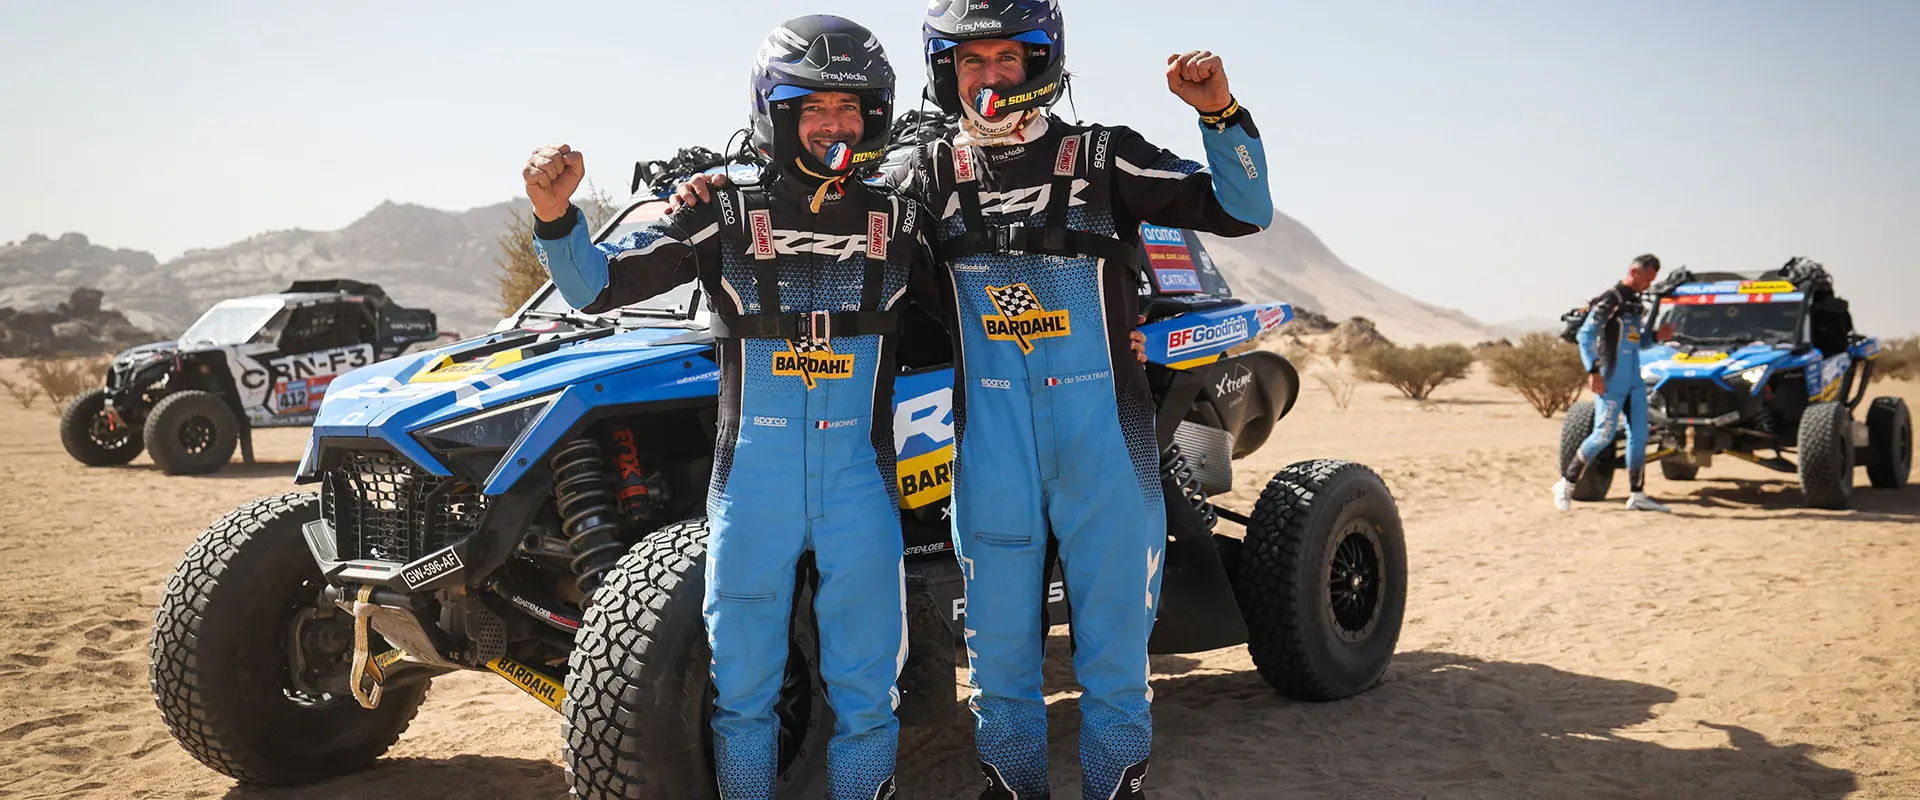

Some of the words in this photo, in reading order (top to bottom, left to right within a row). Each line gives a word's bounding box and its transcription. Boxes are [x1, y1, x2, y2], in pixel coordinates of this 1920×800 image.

[974, 119, 1012, 133] sparco
[959, 149, 971, 179] SIMPSON
[1060, 139, 1076, 171] SIMPSON
[1093, 131, 1111, 170] sparco
[1234, 144, 1259, 180] sparco
[754, 215, 769, 254] SIMPSON
[872, 216, 884, 254] SIMPSON
[1144, 227, 1181, 242] aramco
[985, 316, 1066, 336] BARDAHL
[1169, 316, 1247, 349] BFGoodrich
[776, 356, 850, 374] BARDAHL
[981, 378, 1011, 389] sparco
[280, 390, 306, 408] 412
[753, 416, 787, 426] sparco
[405, 553, 456, 584] GW-596-AF
[496, 656, 558, 703] BARDAHL
